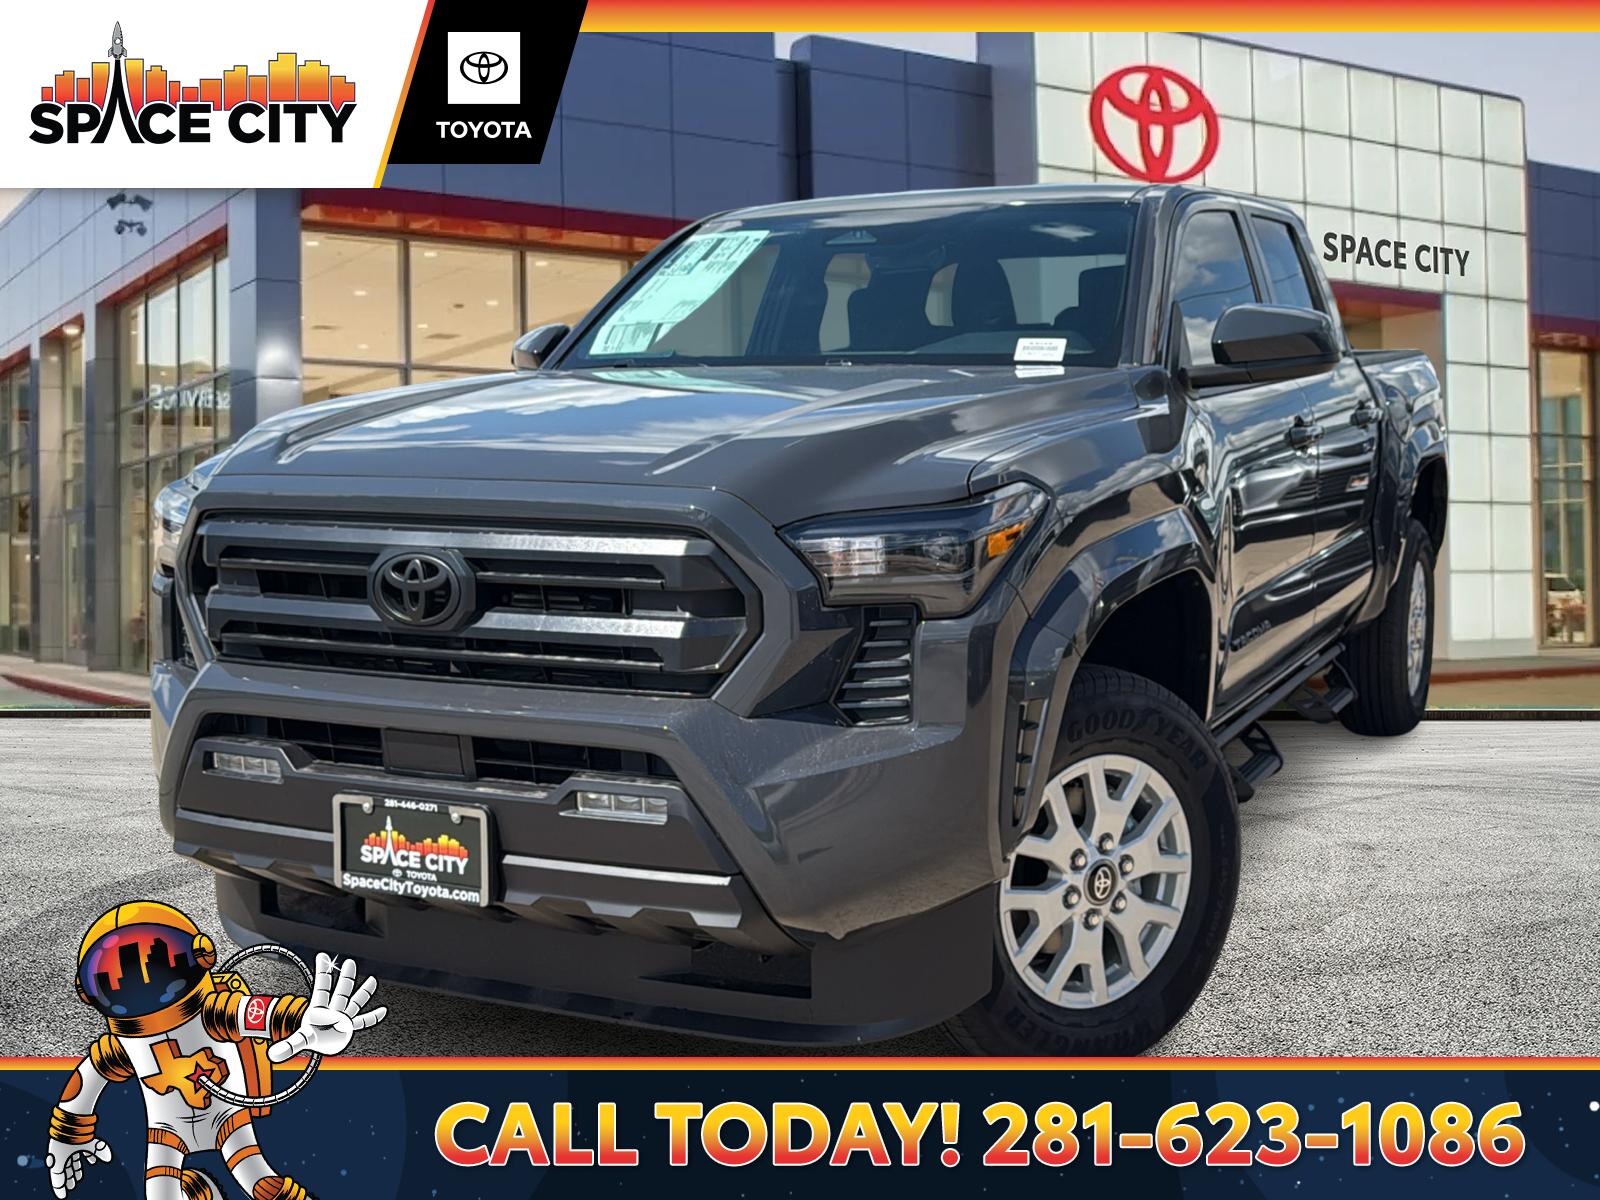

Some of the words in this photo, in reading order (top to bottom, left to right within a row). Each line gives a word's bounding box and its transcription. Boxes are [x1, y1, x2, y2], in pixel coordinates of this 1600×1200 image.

[1323, 232, 1407, 270] SPACE
[1415, 244, 1470, 276] CITY
[1067, 708, 1208, 770] GOODYEAR
[360, 839, 422, 868] SPACE
[425, 853, 469, 875] CITY
[343, 873, 480, 903] SpaceCityToyota.com
[406, 870, 437, 882] TOYOTA
